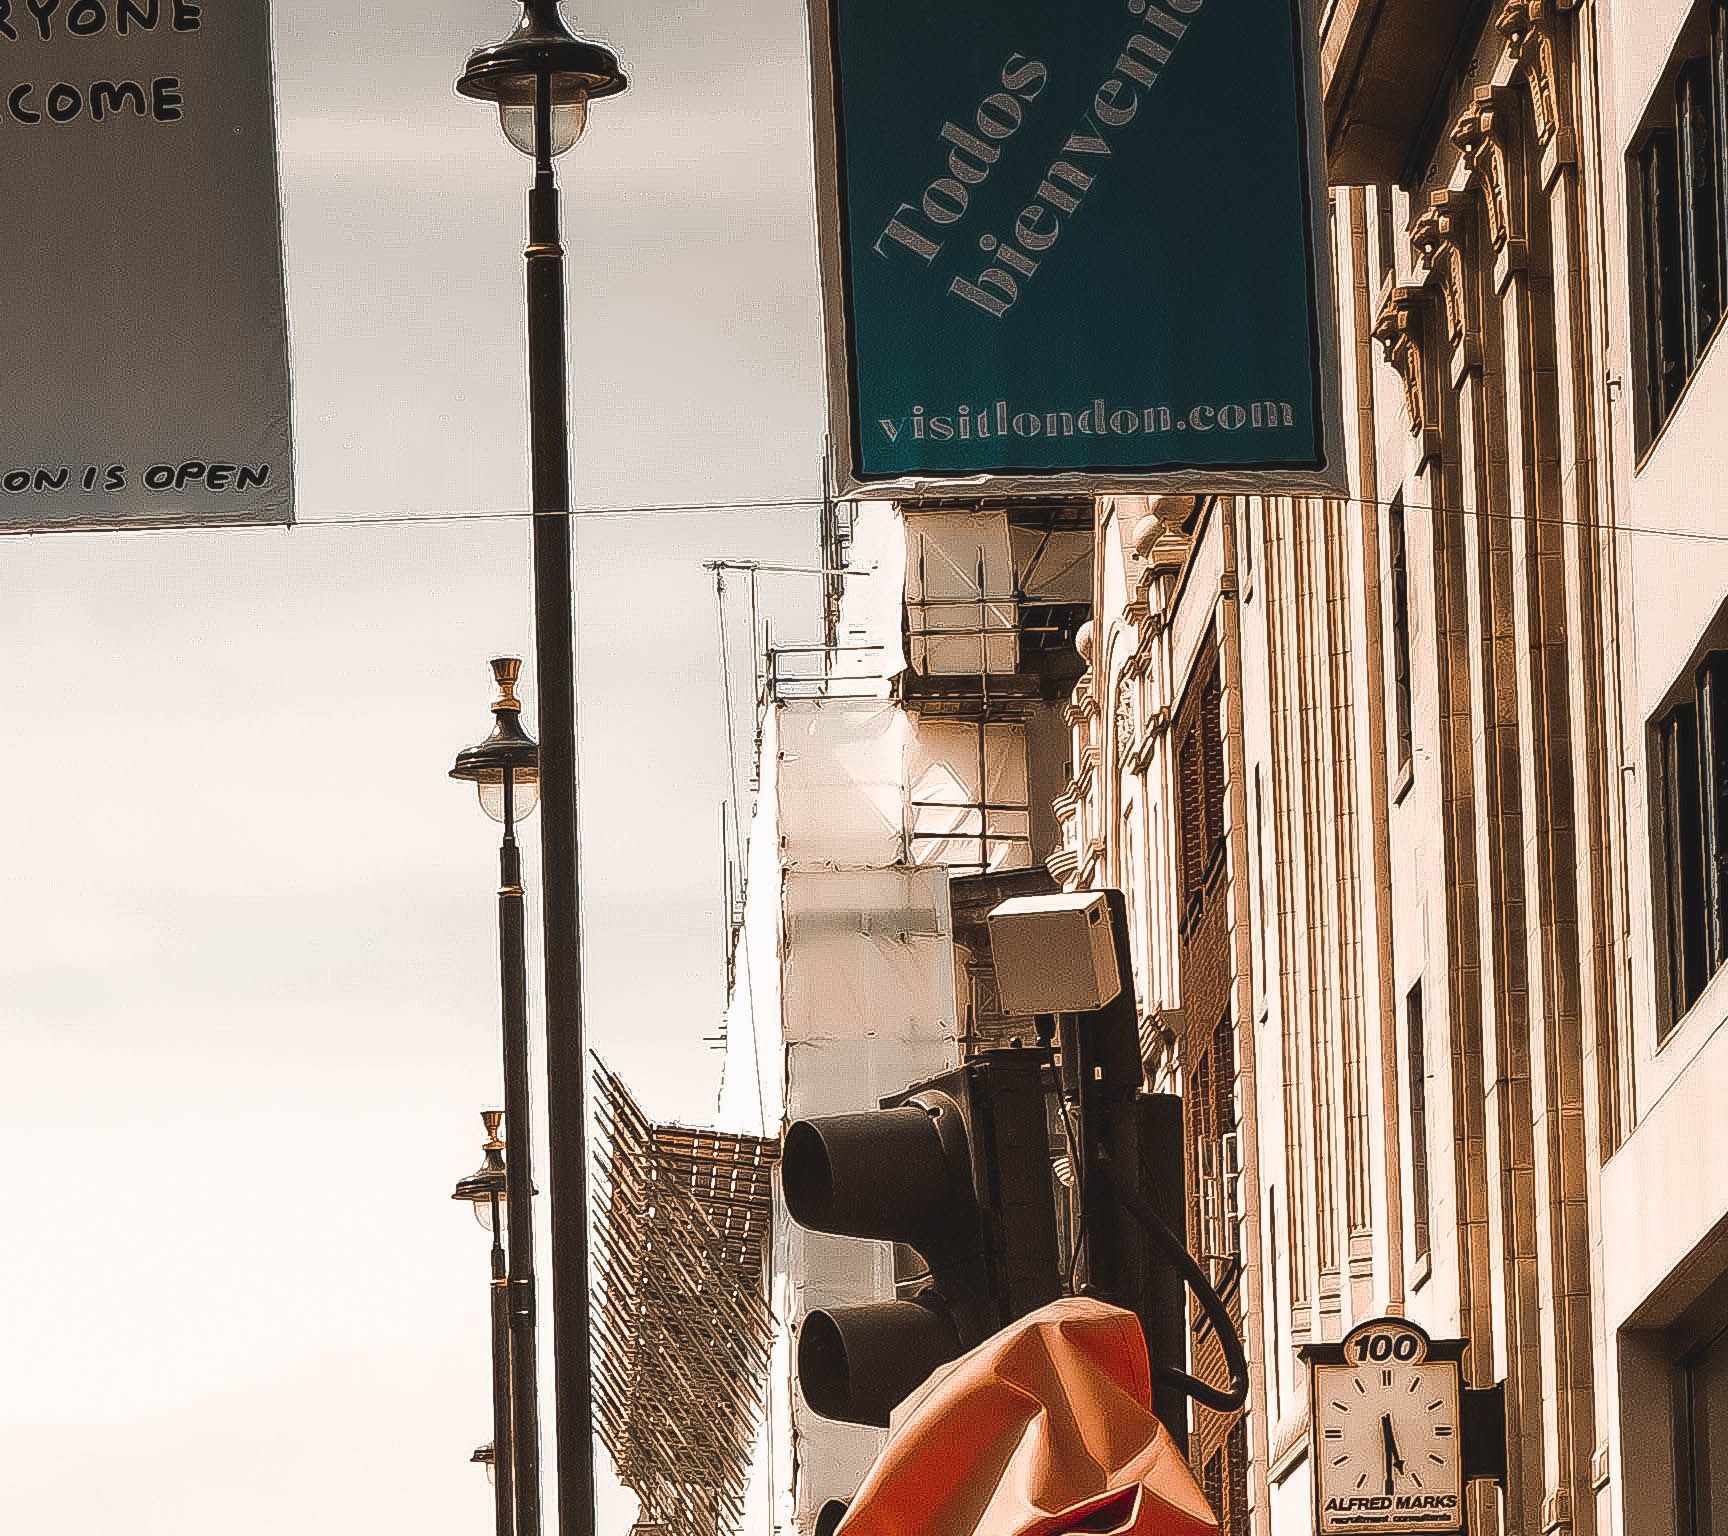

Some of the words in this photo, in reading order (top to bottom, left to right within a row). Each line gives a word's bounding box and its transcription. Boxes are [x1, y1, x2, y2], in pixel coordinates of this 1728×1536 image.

[873, 50, 1051, 268] Todos
[946, 0, 1206, 320] bienveni
[878, 398, 1296, 445] visitlondon.com
[82, 463, 127, 491] IS
[143, 462, 271, 492] OPEN
[1353, 1334, 1419, 1362] 100
[1324, 1497, 1392, 1512] ALFRED
[1395, 1494, 1459, 1509] MARKS
